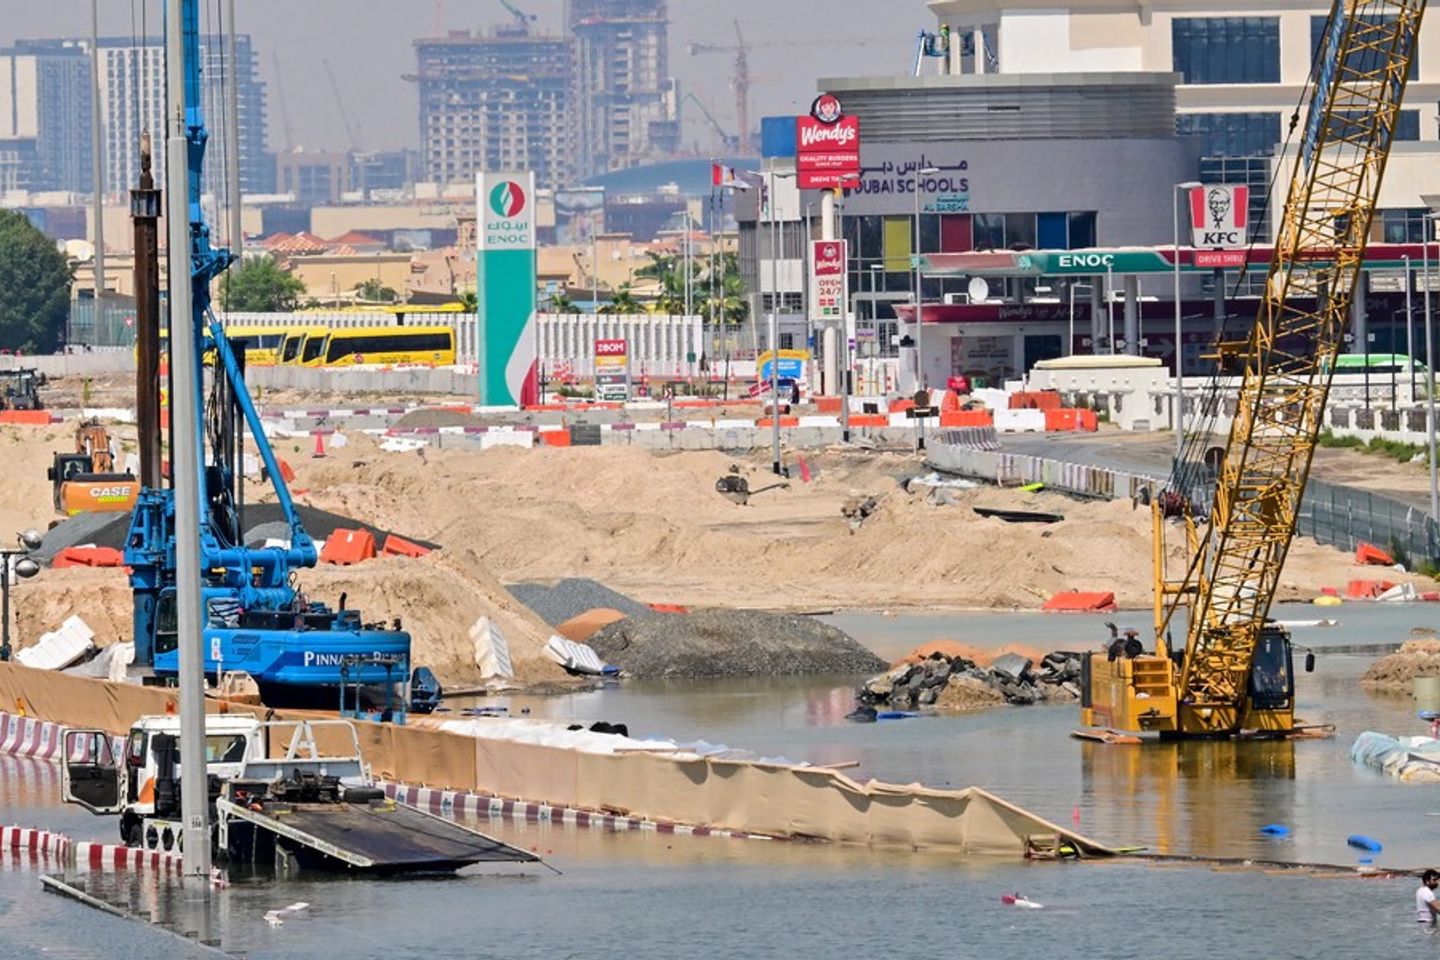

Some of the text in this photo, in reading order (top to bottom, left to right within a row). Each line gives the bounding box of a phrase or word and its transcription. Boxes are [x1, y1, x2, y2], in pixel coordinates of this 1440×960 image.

[801, 122, 856, 146] Wendy's
[897, 178, 969, 193] SCHOOLS
[487, 235, 528, 244] ENOC
[1203, 232, 1238, 245] KFC
[1059, 254, 1115, 267] ENOC
[1199, 254, 1244, 264] DRIVE THRU
[819, 287, 842, 295] 24/7
[597, 343, 624, 352] ZOOM
[89, 486, 131, 497] CASE
[303, 651, 369, 667] PINNAC
